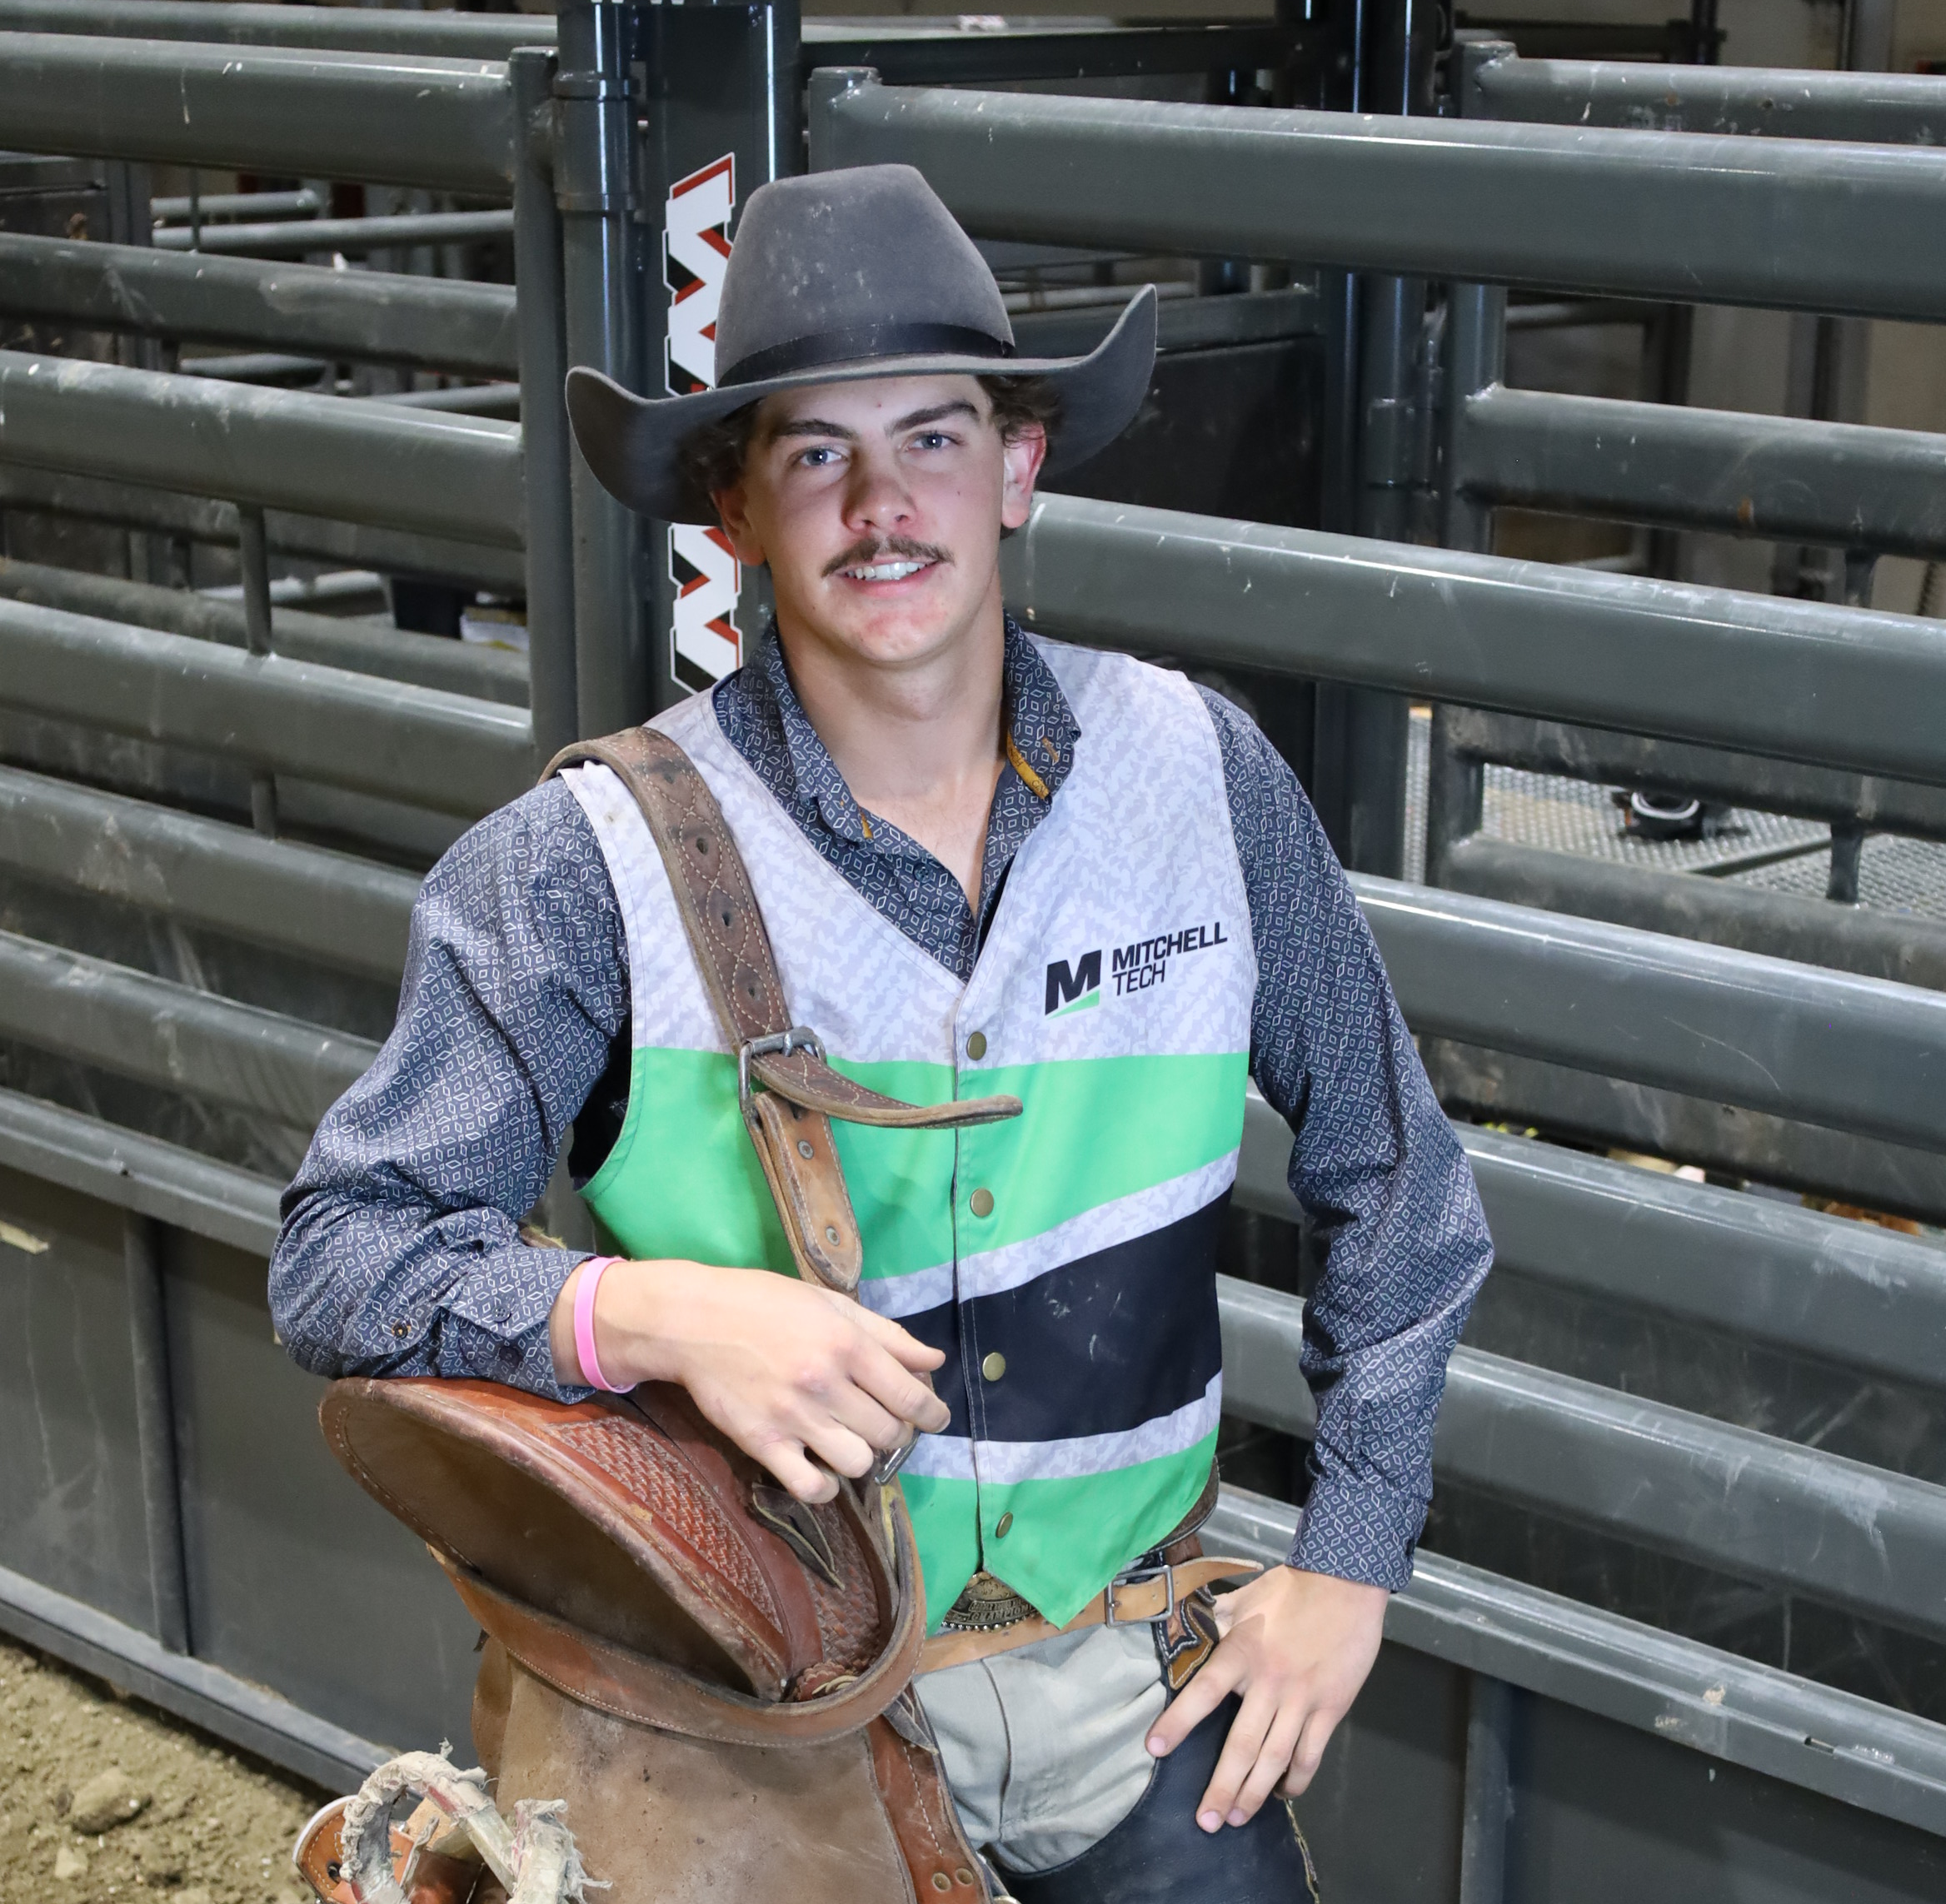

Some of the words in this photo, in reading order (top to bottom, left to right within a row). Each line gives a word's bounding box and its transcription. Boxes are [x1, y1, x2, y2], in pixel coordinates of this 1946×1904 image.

[1111, 921, 1229, 973] MITCHELL
[1045, 950, 1102, 1016] M
[1111, 960, 1166, 997] TECH
